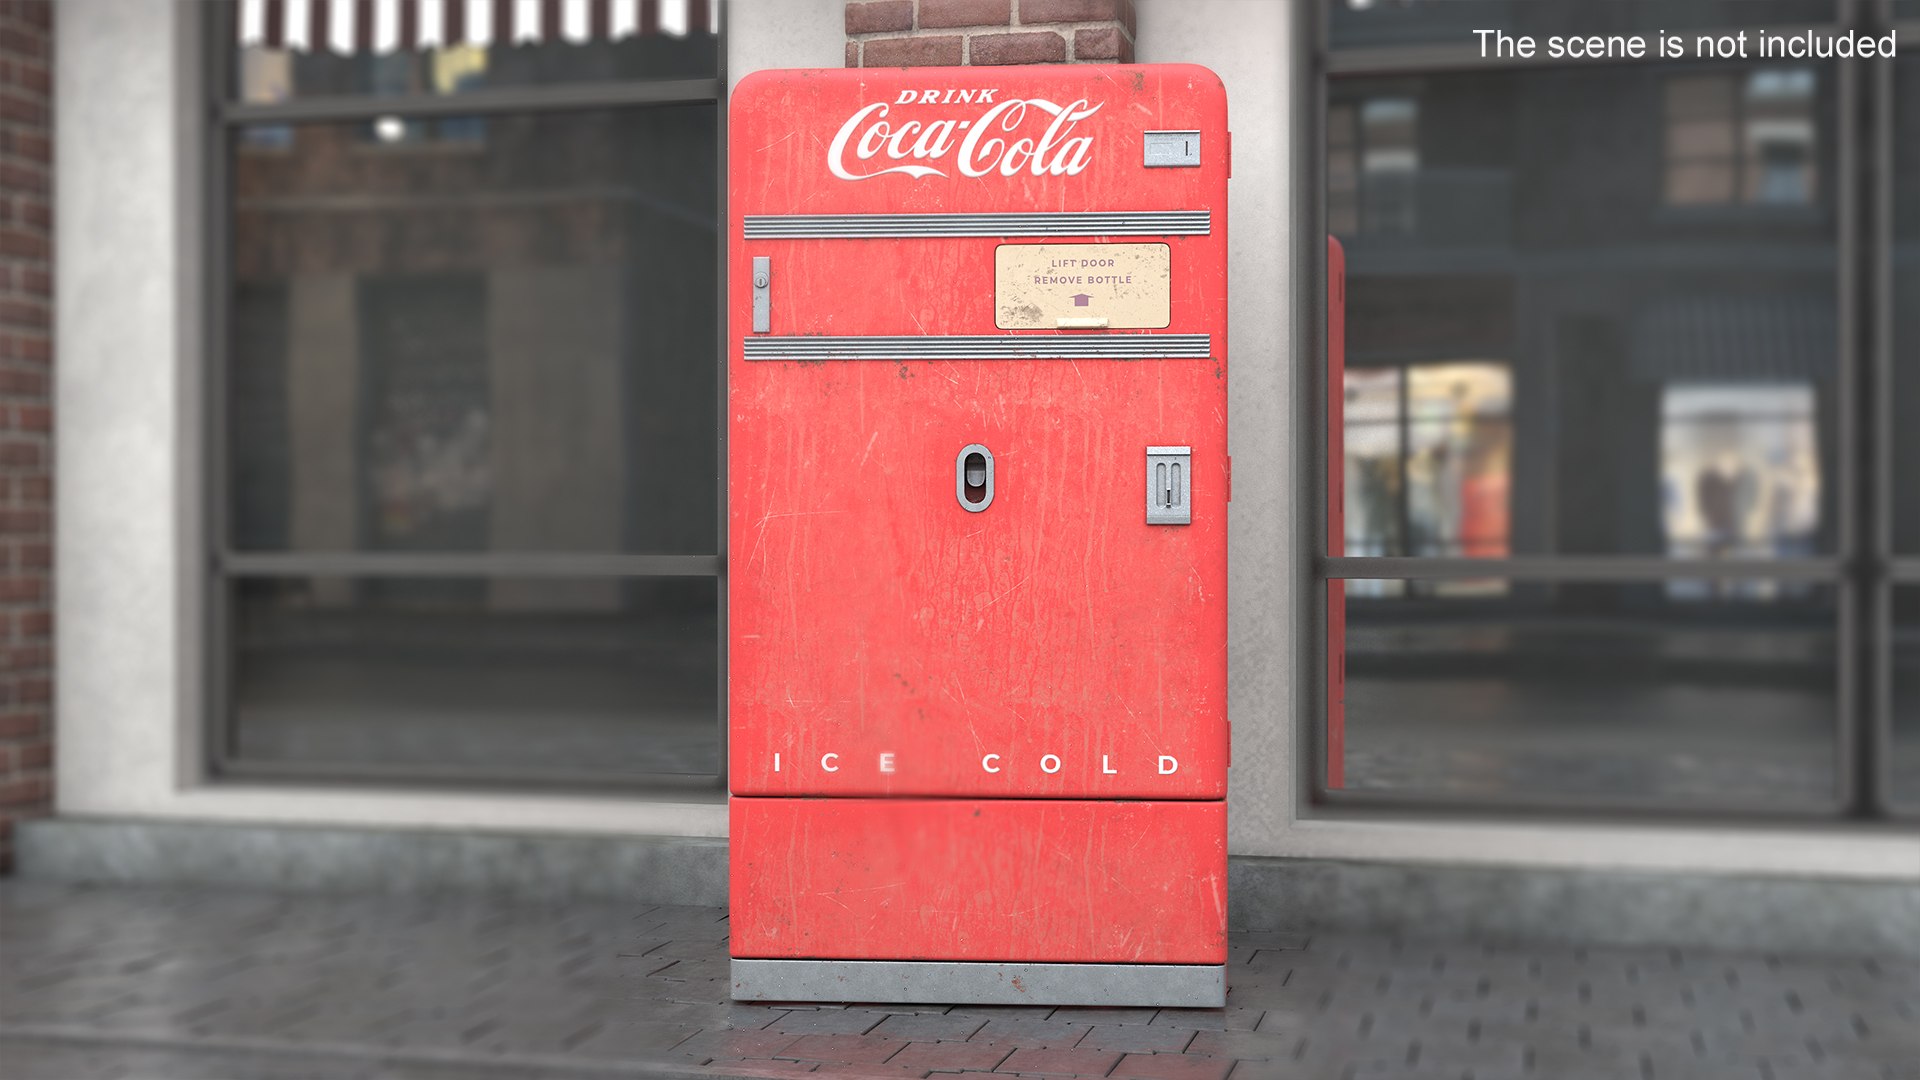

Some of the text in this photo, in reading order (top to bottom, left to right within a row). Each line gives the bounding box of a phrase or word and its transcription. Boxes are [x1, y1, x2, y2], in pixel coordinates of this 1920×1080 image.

[895, 88, 999, 105] DRINK
[827, 98, 1105, 181] Coca-Cola
[1052, 259, 1115, 268] LIFT DOOR
[1035, 276, 1131, 284] REMOVE BOTTLE
[774, 752, 1180, 776] ICE COLD
